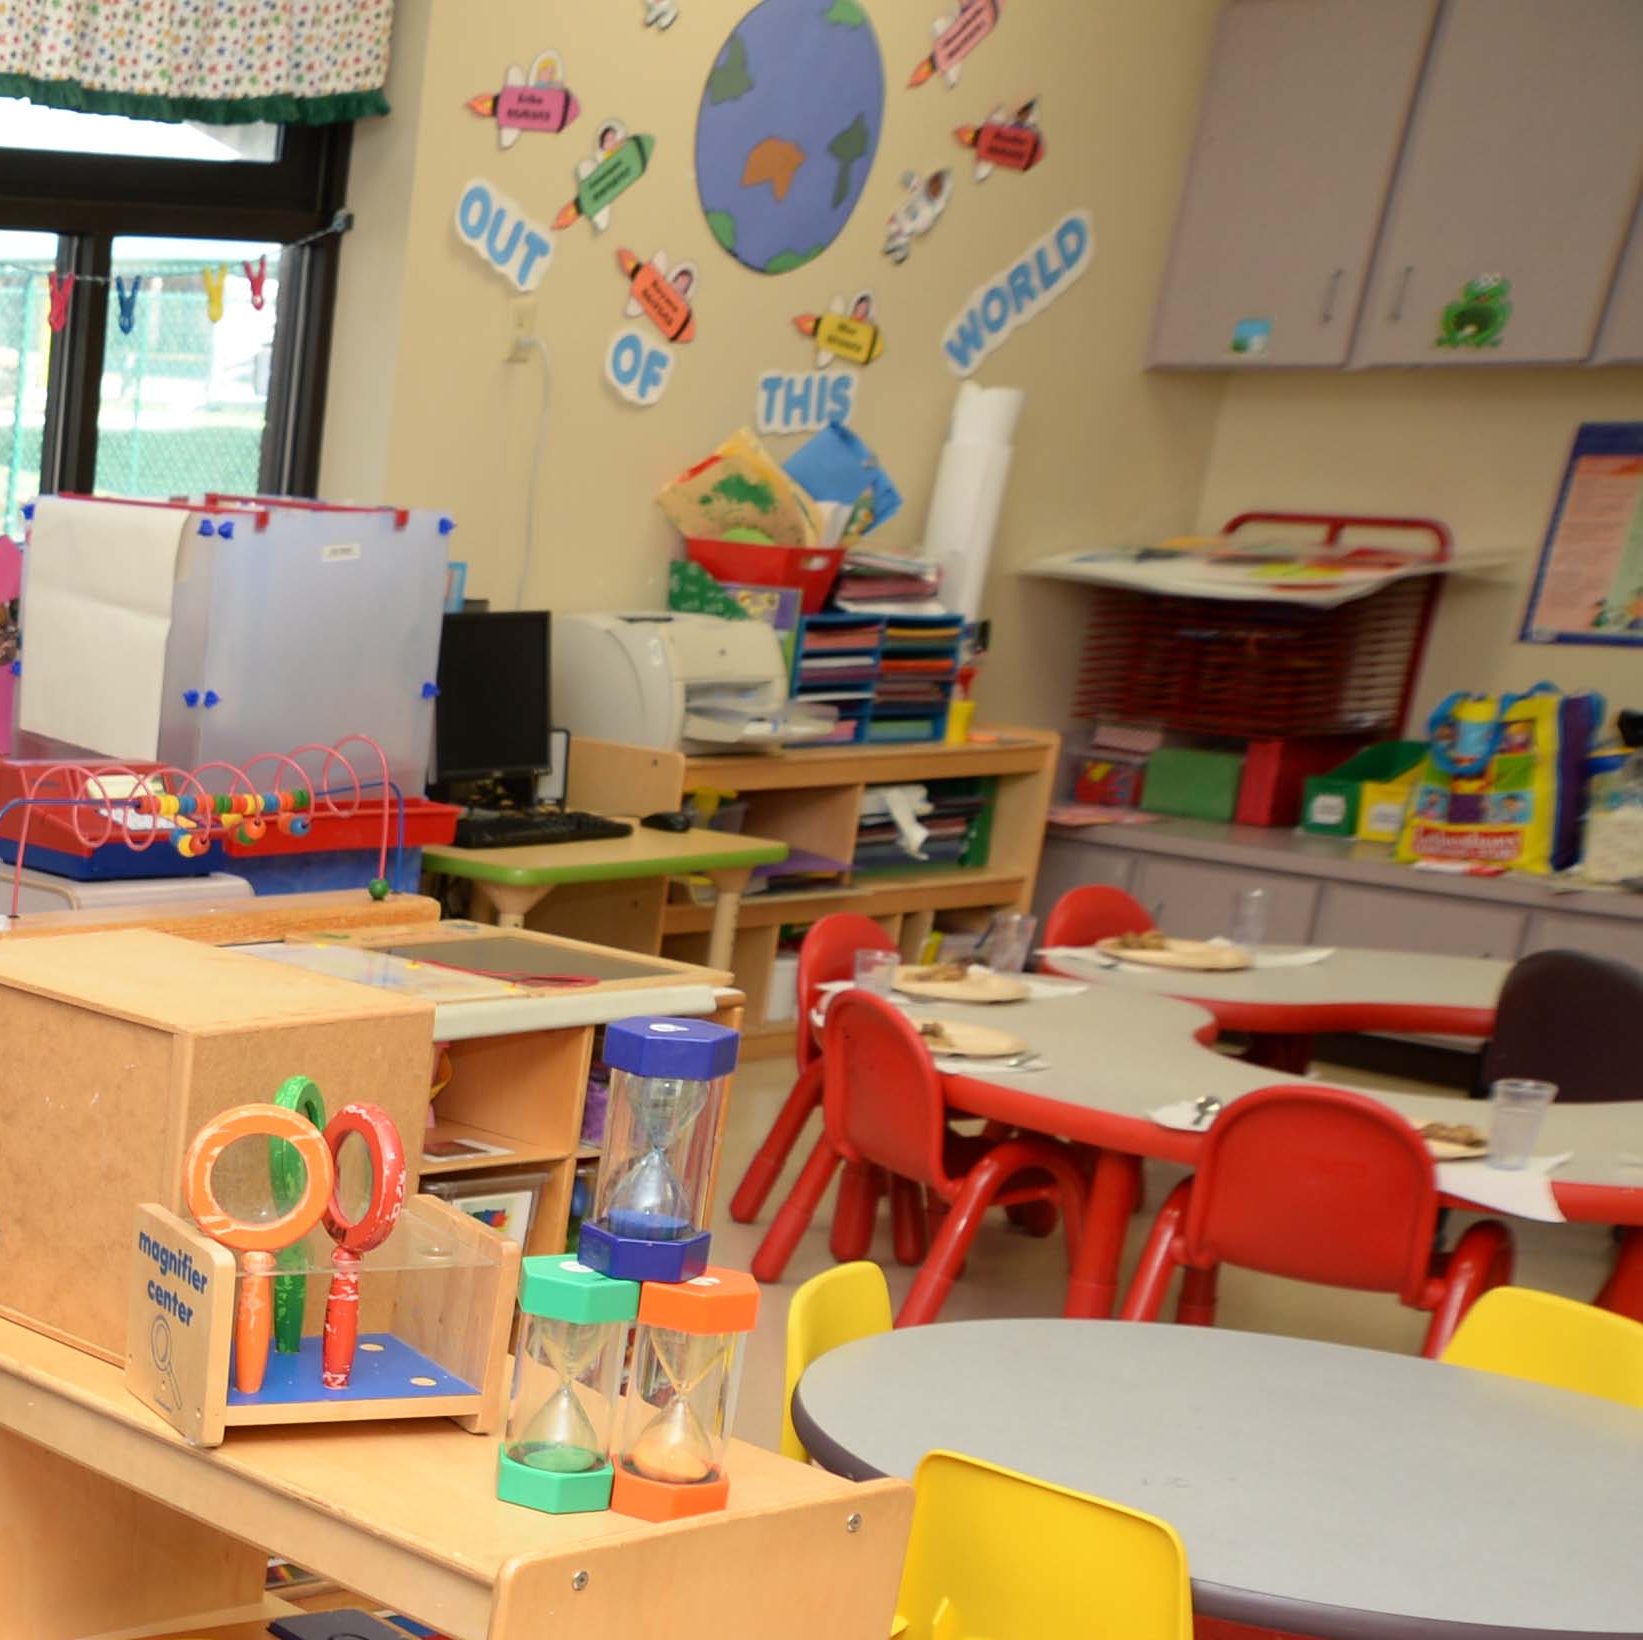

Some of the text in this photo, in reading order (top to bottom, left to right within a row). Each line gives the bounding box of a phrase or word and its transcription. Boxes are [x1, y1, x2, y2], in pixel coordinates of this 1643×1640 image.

[459, 184, 552, 287] OUT
[943, 215, 1091, 370] WORLD
[611, 333, 670, 400] OF
[761, 374, 853, 428] THIS
[138, 1231, 208, 1295] magnifier
[147, 1279, 194, 1327] center
